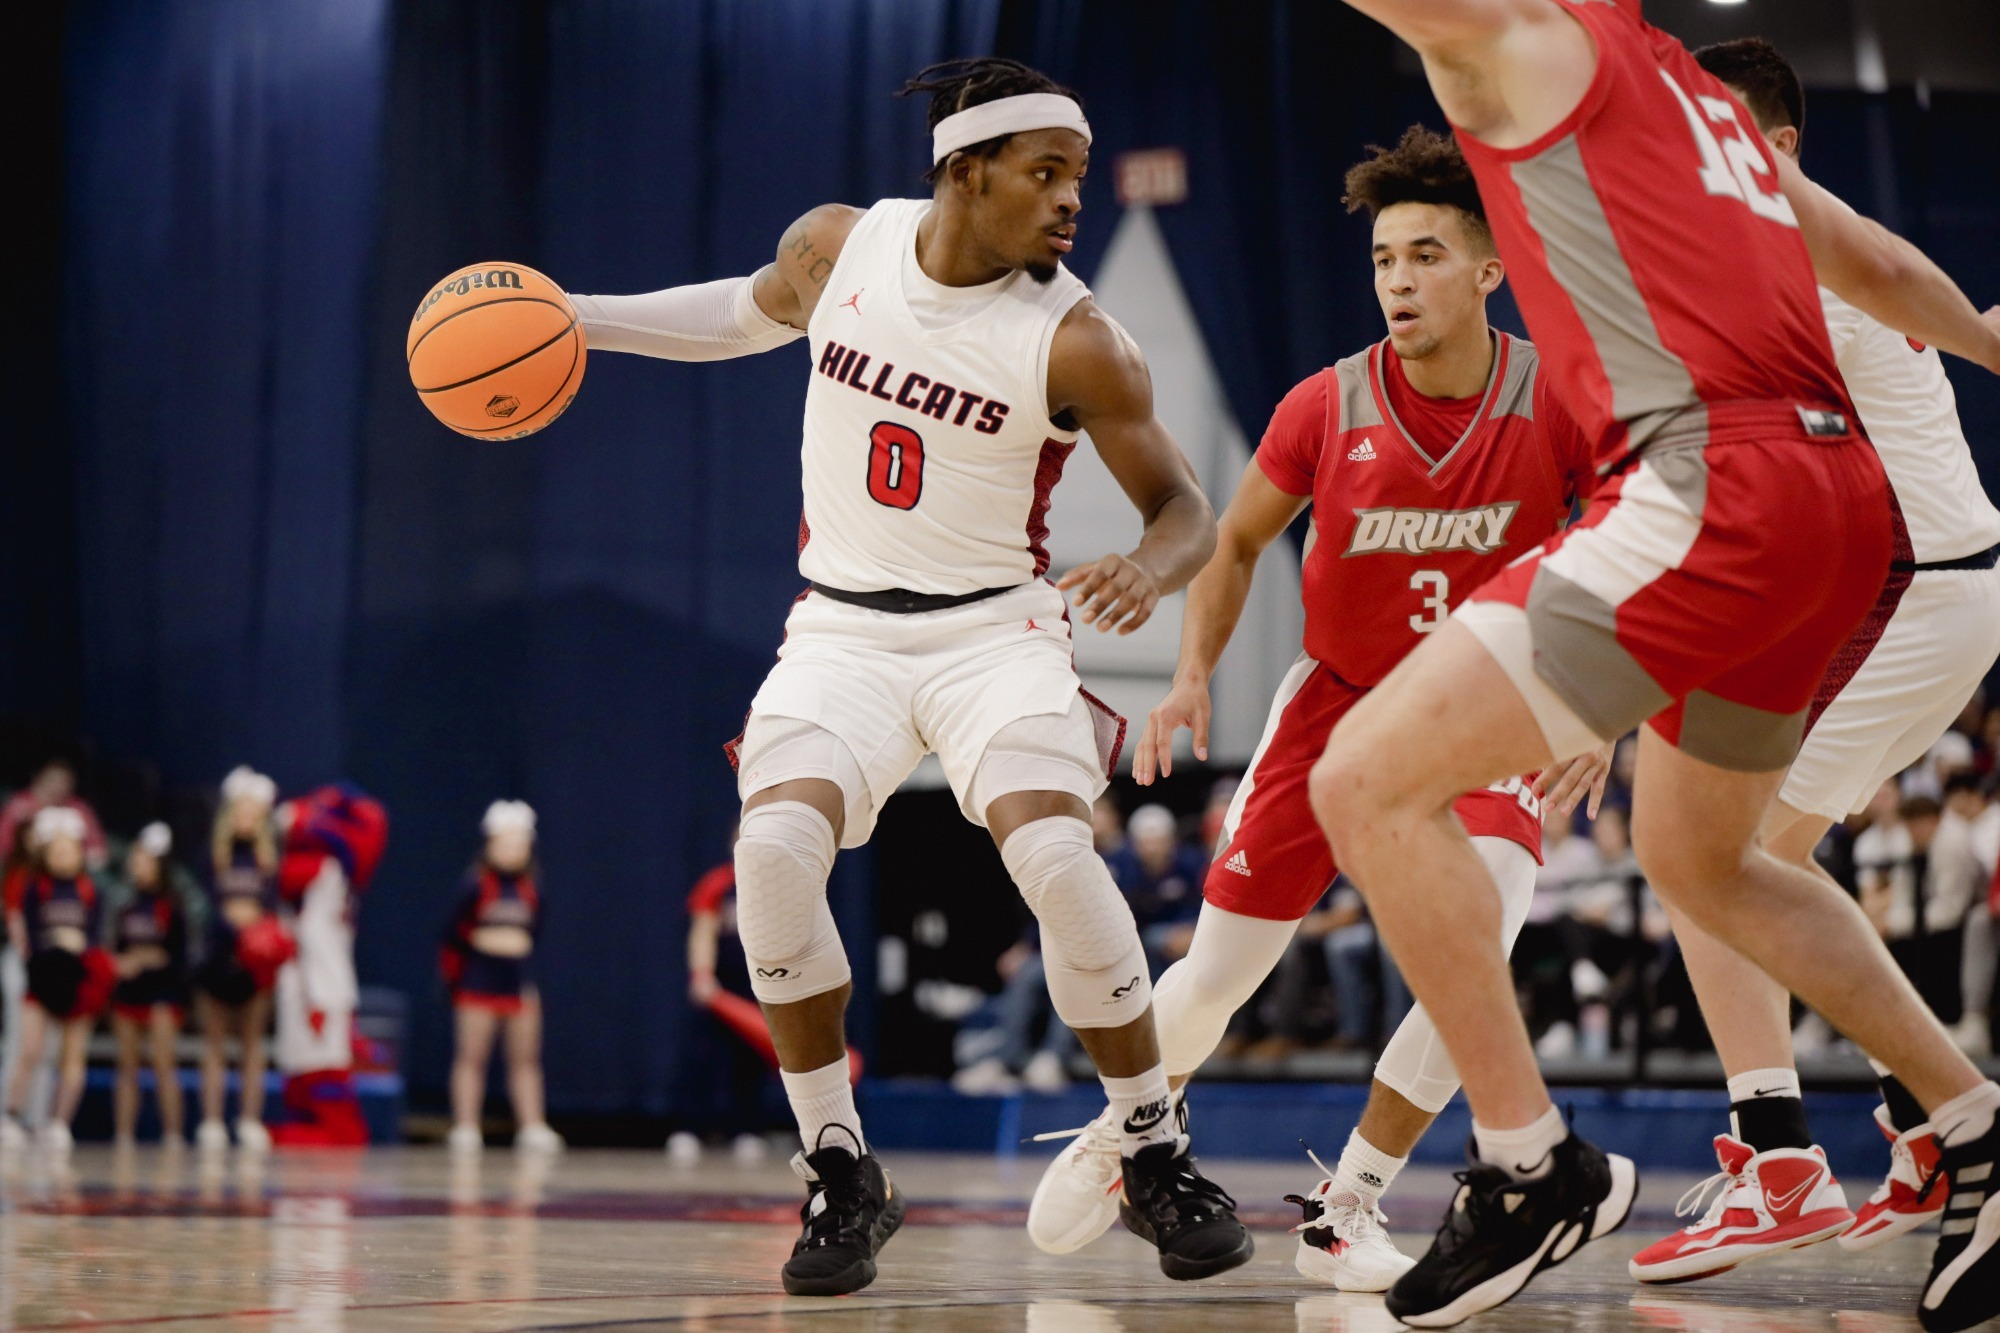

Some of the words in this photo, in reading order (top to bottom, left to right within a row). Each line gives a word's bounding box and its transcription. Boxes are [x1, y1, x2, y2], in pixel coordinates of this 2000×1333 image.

[1658, 67, 1800, 229] 12
[415, 269, 524, 322] Wilson
[818, 340, 1010, 435] HILLCATS
[866, 420, 925, 512] 0
[1347, 451, 1377, 462] adidas
[1348, 505, 1515, 554] DRURY
[1409, 569, 1449, 634] 3
[1224, 861, 1252, 877] adidas
[1131, 1095, 1169, 1122] NIKE
